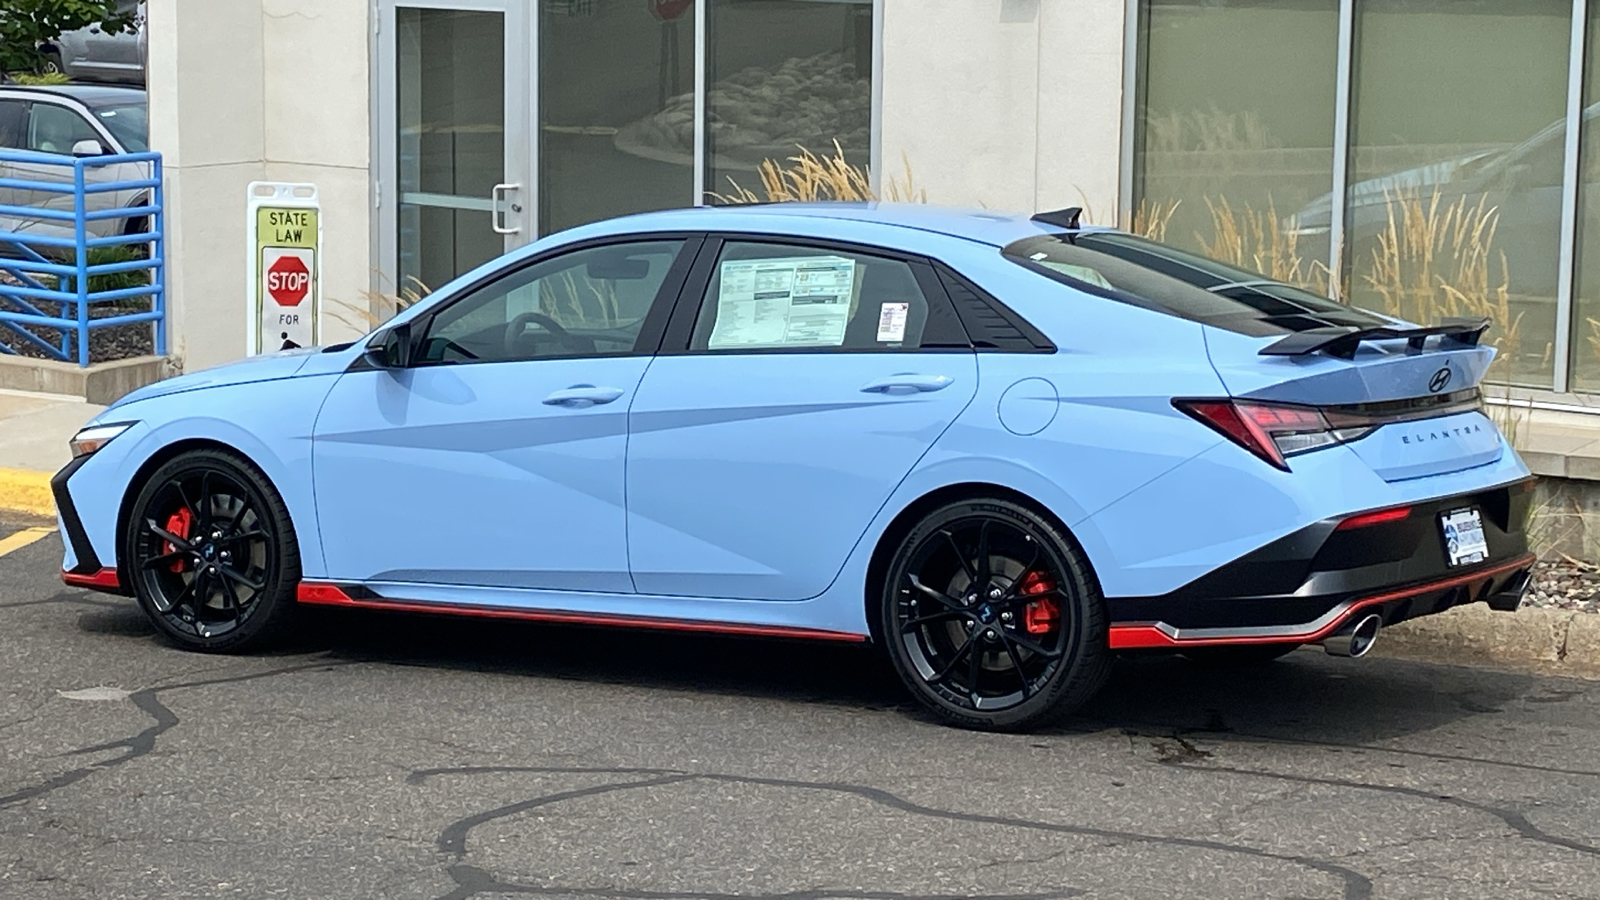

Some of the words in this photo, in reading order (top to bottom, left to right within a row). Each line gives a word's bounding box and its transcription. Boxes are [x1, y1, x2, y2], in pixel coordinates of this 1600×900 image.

[269, 211, 308, 226] STATE
[275, 229, 303, 243] LAW
[268, 272, 309, 291] STOP
[279, 314, 300, 325] FOR
[1401, 424, 1481, 445] ELANTRA
